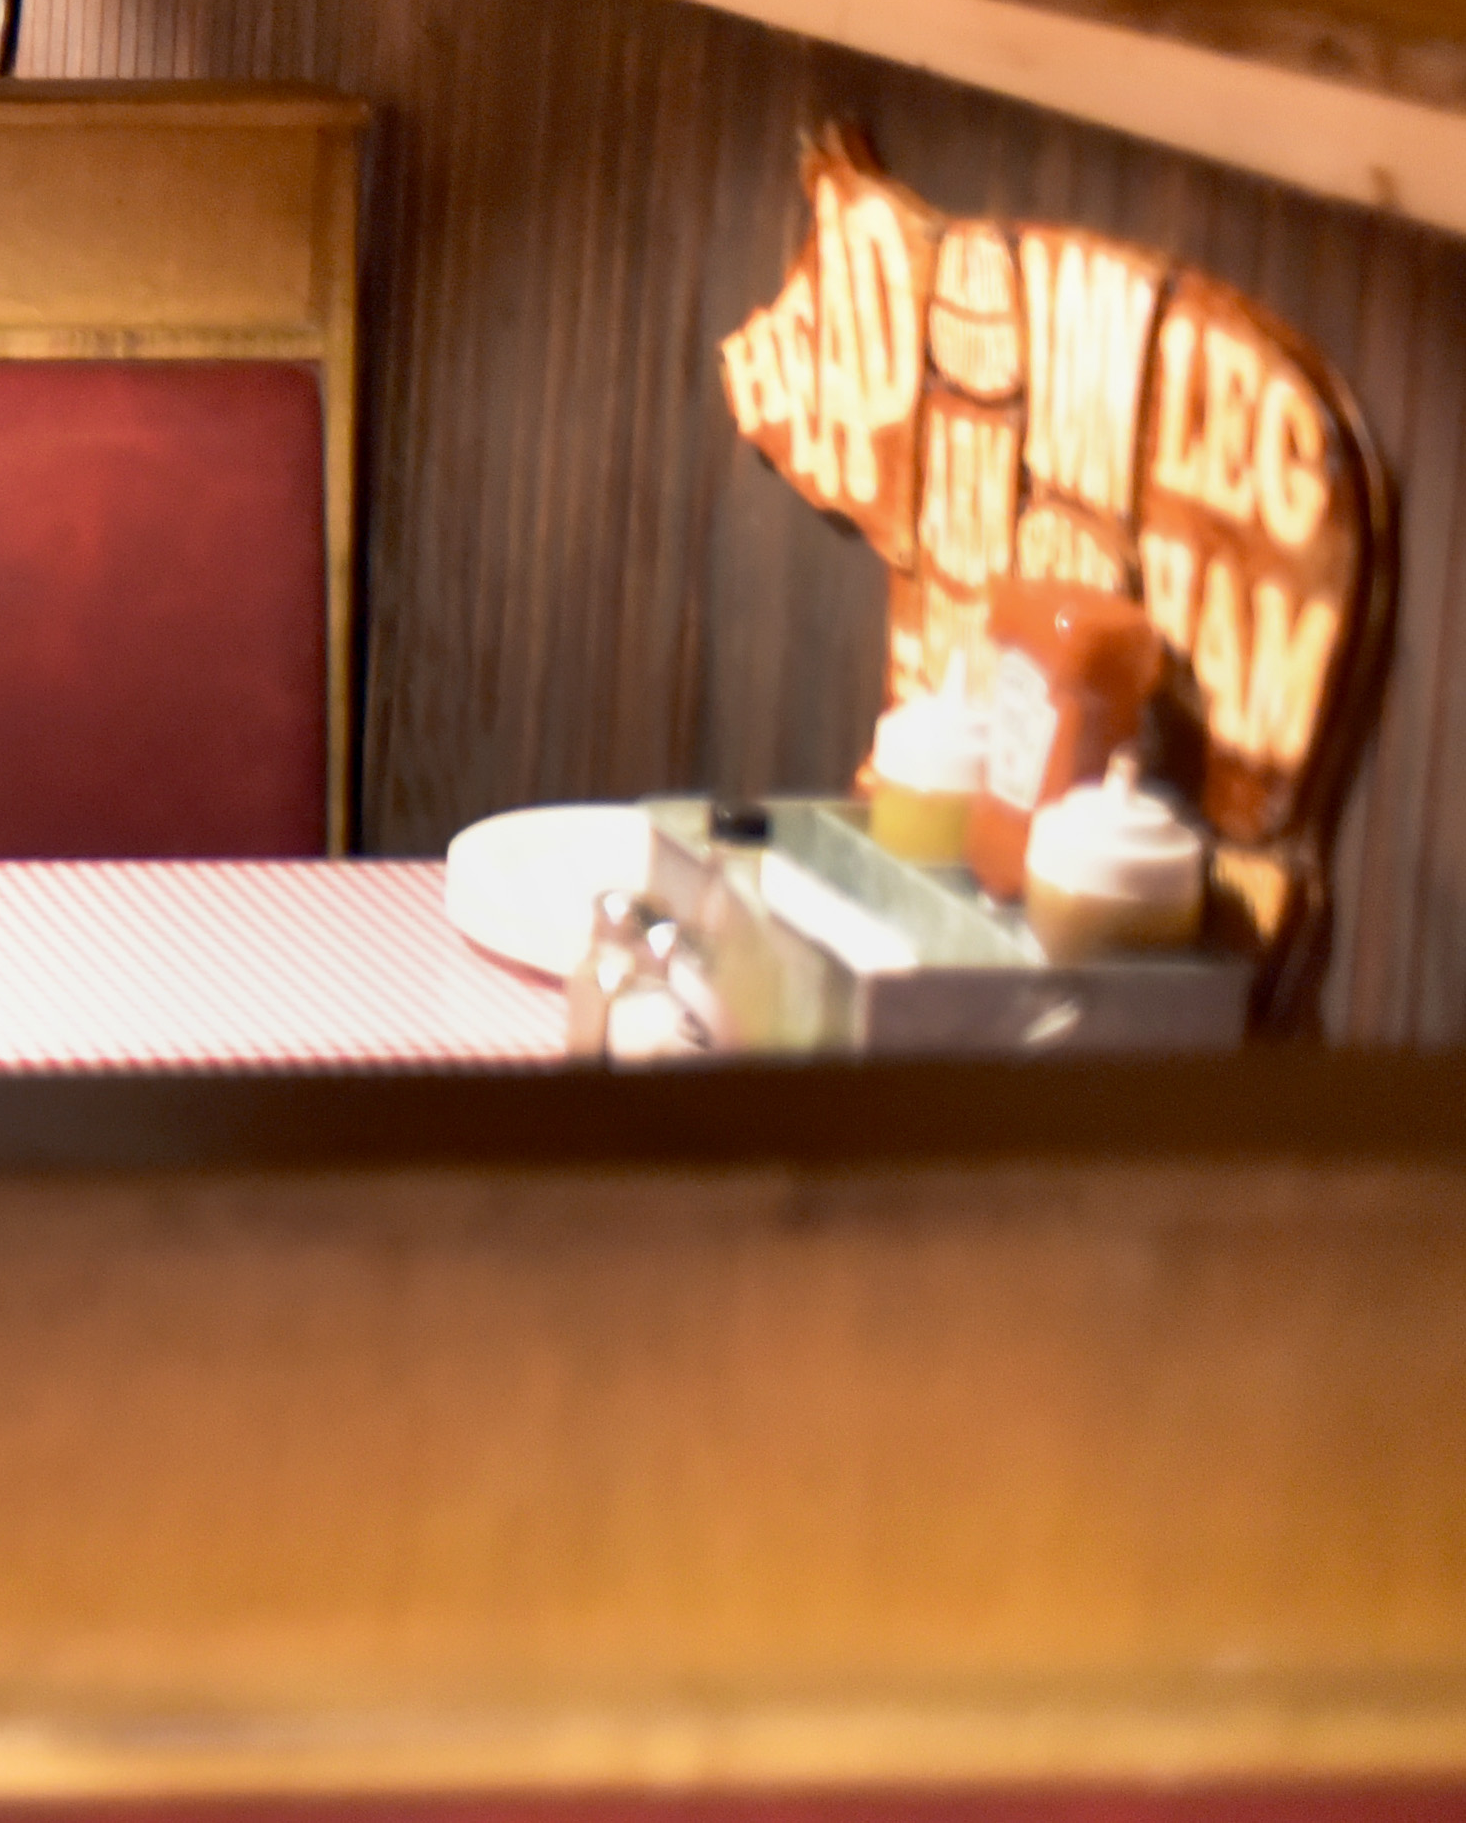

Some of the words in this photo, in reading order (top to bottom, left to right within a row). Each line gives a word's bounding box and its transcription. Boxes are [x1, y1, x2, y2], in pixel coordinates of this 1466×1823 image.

[721, 175, 918, 502] HEAD
[1154, 316, 1327, 545] LEG
[1138, 534, 1340, 761] HAM
